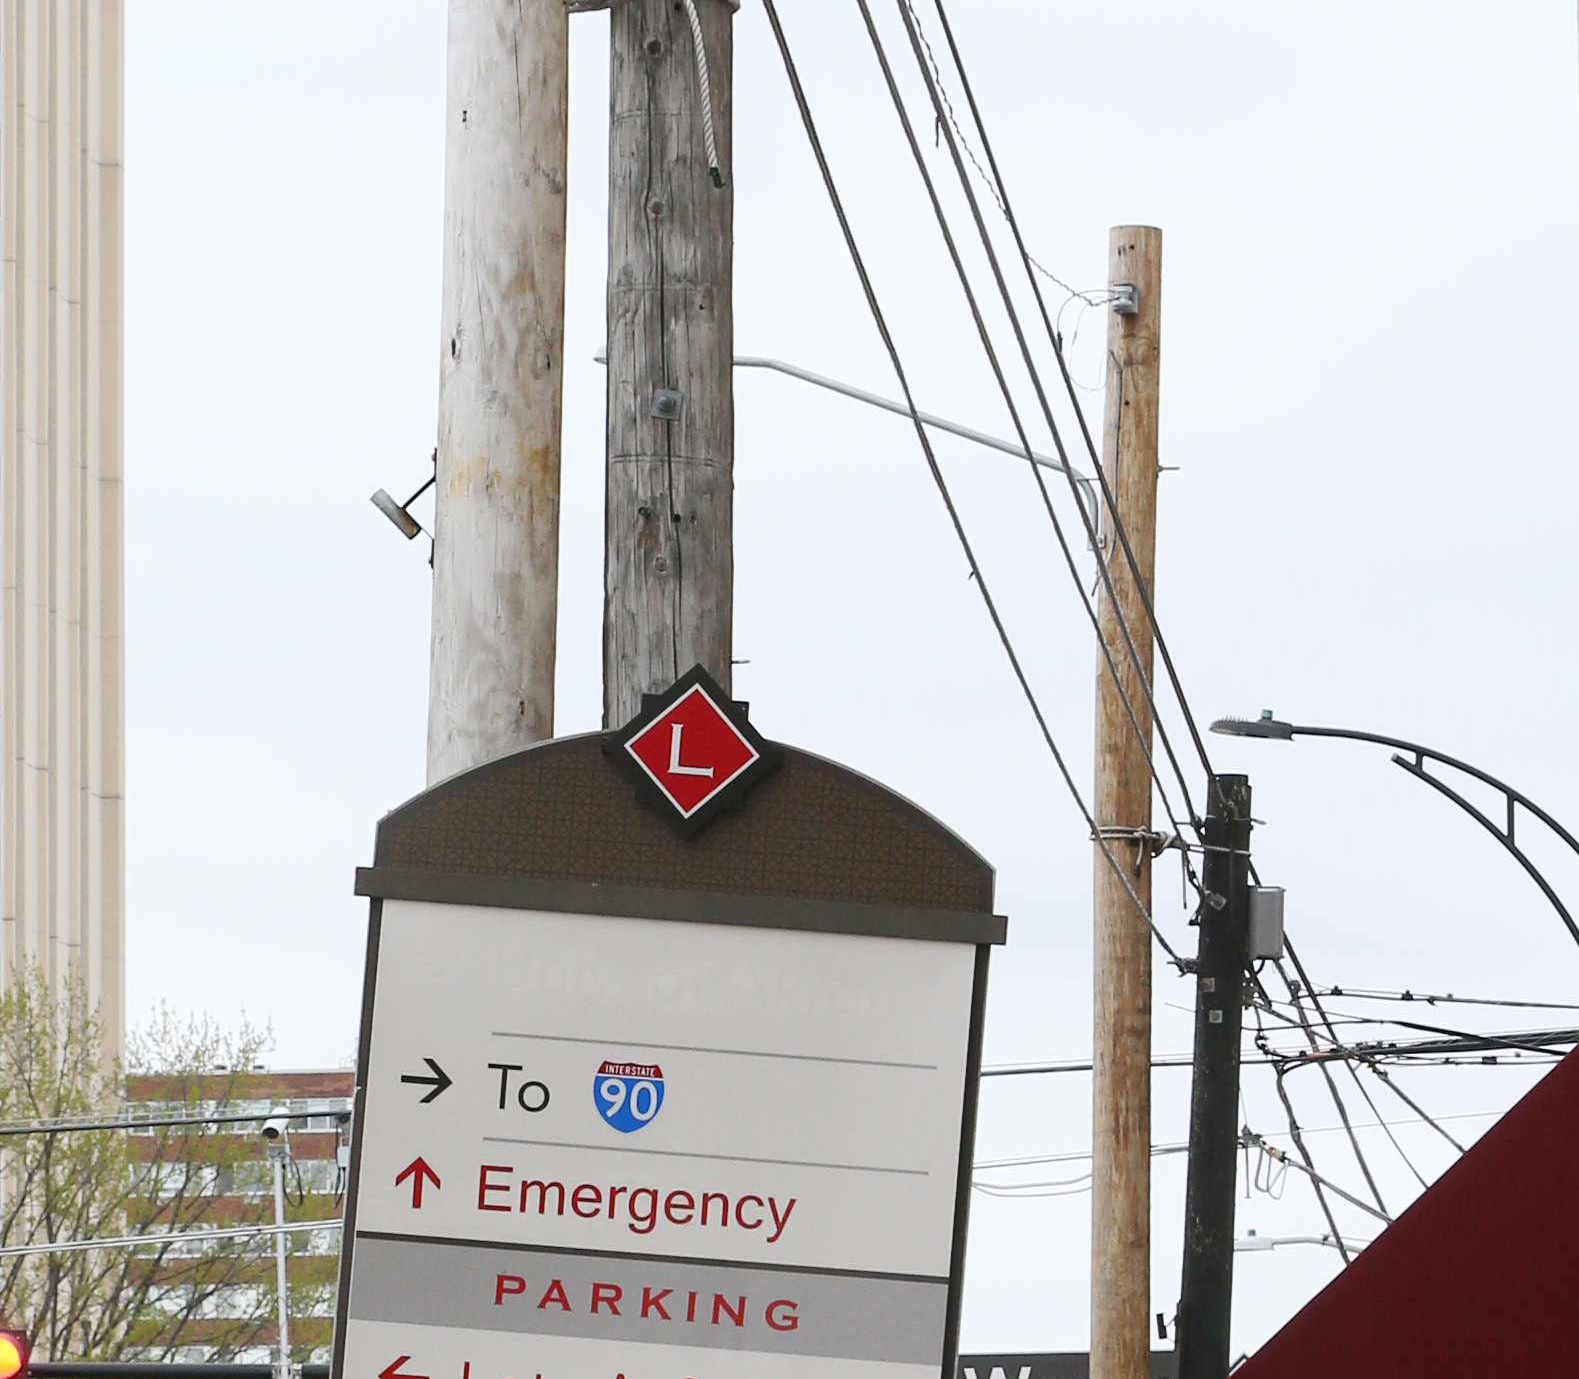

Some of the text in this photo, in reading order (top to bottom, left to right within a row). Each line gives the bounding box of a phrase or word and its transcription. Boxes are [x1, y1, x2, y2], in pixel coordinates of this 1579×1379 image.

[666, 723, 714, 778] L
[488, 1062, 550, 1113] To
[605, 1064, 656, 1078] INTERSTATE
[600, 1078, 658, 1121] 90
[477, 1164, 797, 1242] Emergency
[495, 1274, 800, 1332] PARKING
